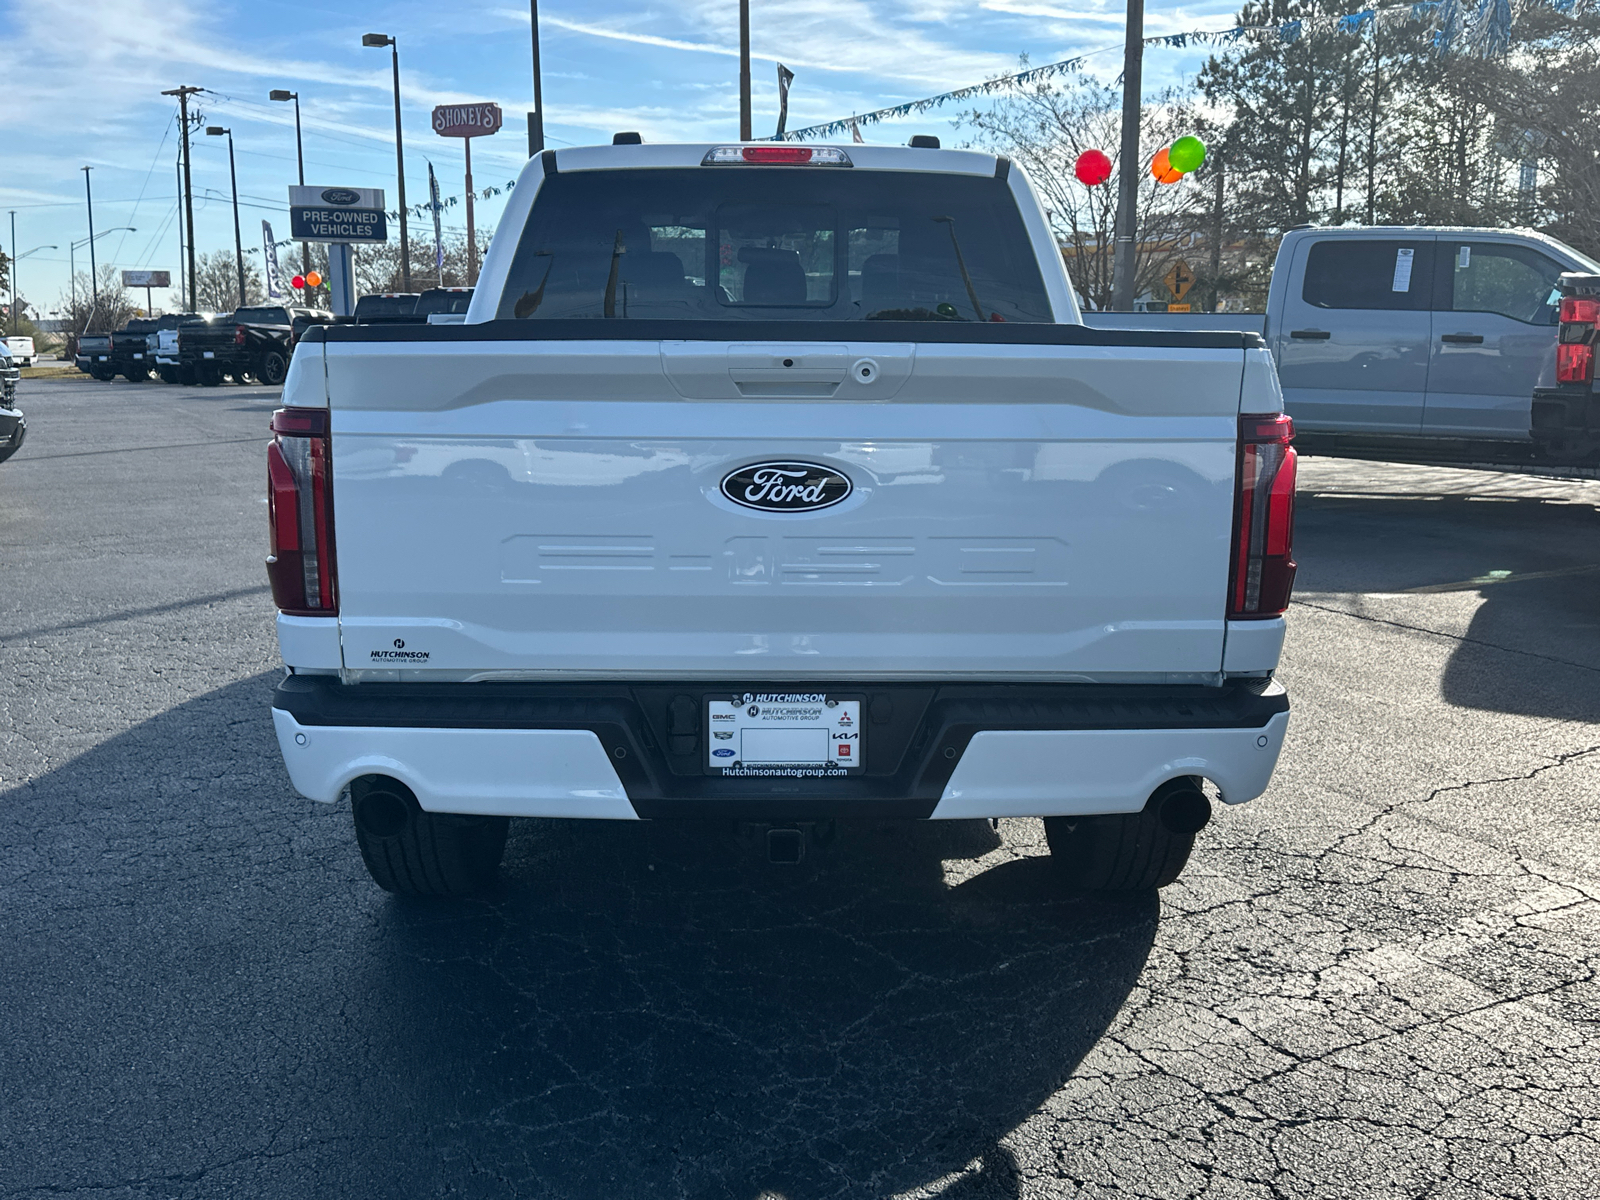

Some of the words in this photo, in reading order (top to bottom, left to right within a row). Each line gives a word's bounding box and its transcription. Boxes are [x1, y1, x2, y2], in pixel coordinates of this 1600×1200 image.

[435, 106, 494, 131] SHONEY'S
[330, 192, 353, 201] Ford
[302, 210, 378, 223] PRE-OWNED
[311, 223, 373, 236] VEHICLES
[744, 468, 830, 503] Ford
[501, 534, 1070, 585] F-150
[755, 694, 826, 702] HUTCHINSON
[722, 768, 848, 777] Hutchinsonautogroup.com
